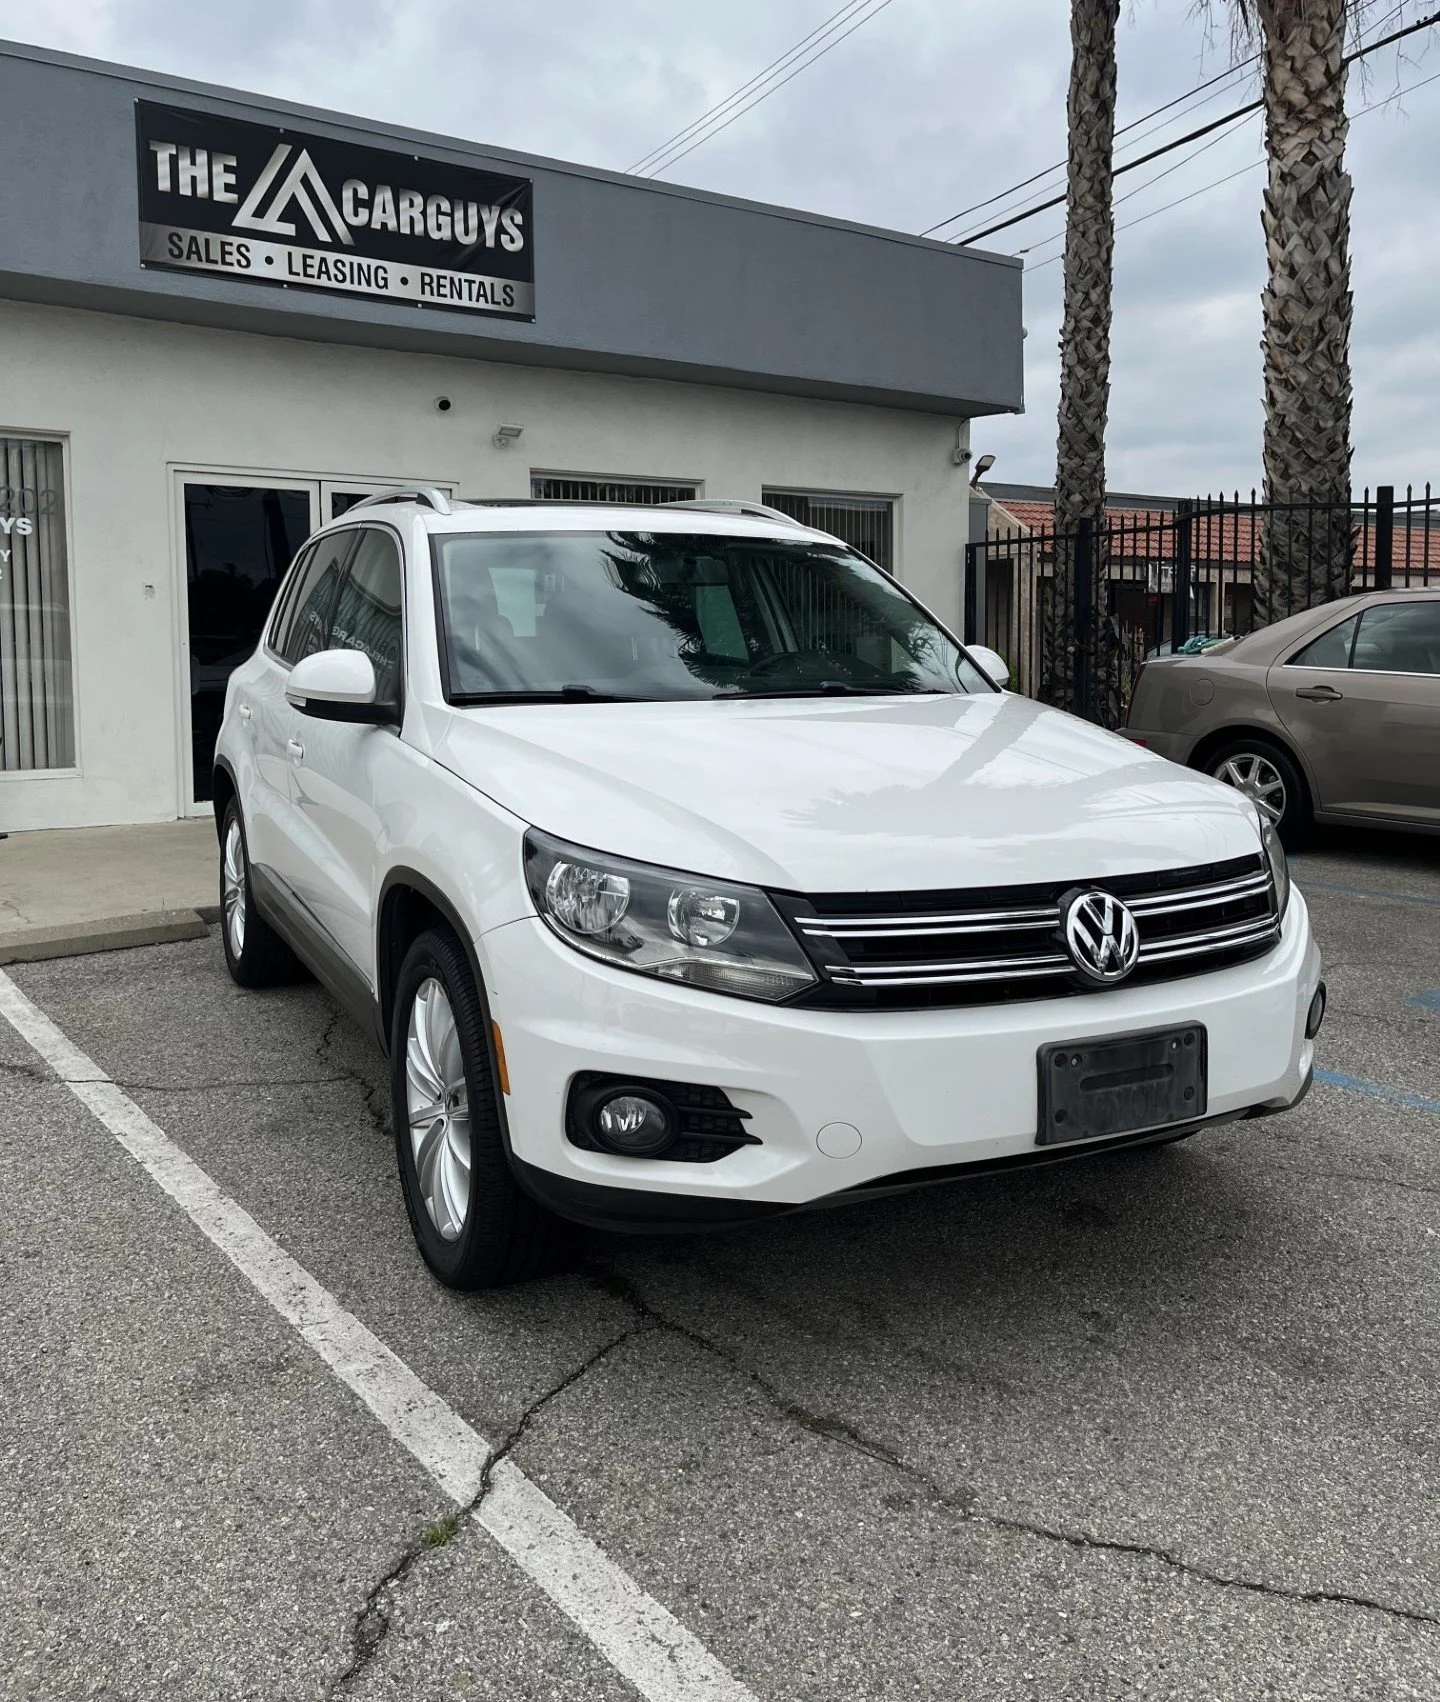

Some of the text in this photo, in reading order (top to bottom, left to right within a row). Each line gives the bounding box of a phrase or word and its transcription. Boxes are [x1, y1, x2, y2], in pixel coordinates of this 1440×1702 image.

[149, 140, 239, 204] THE
[342, 178, 524, 252] CARGUYS
[168, 231, 514, 307] SALES LEASING RENTALS
